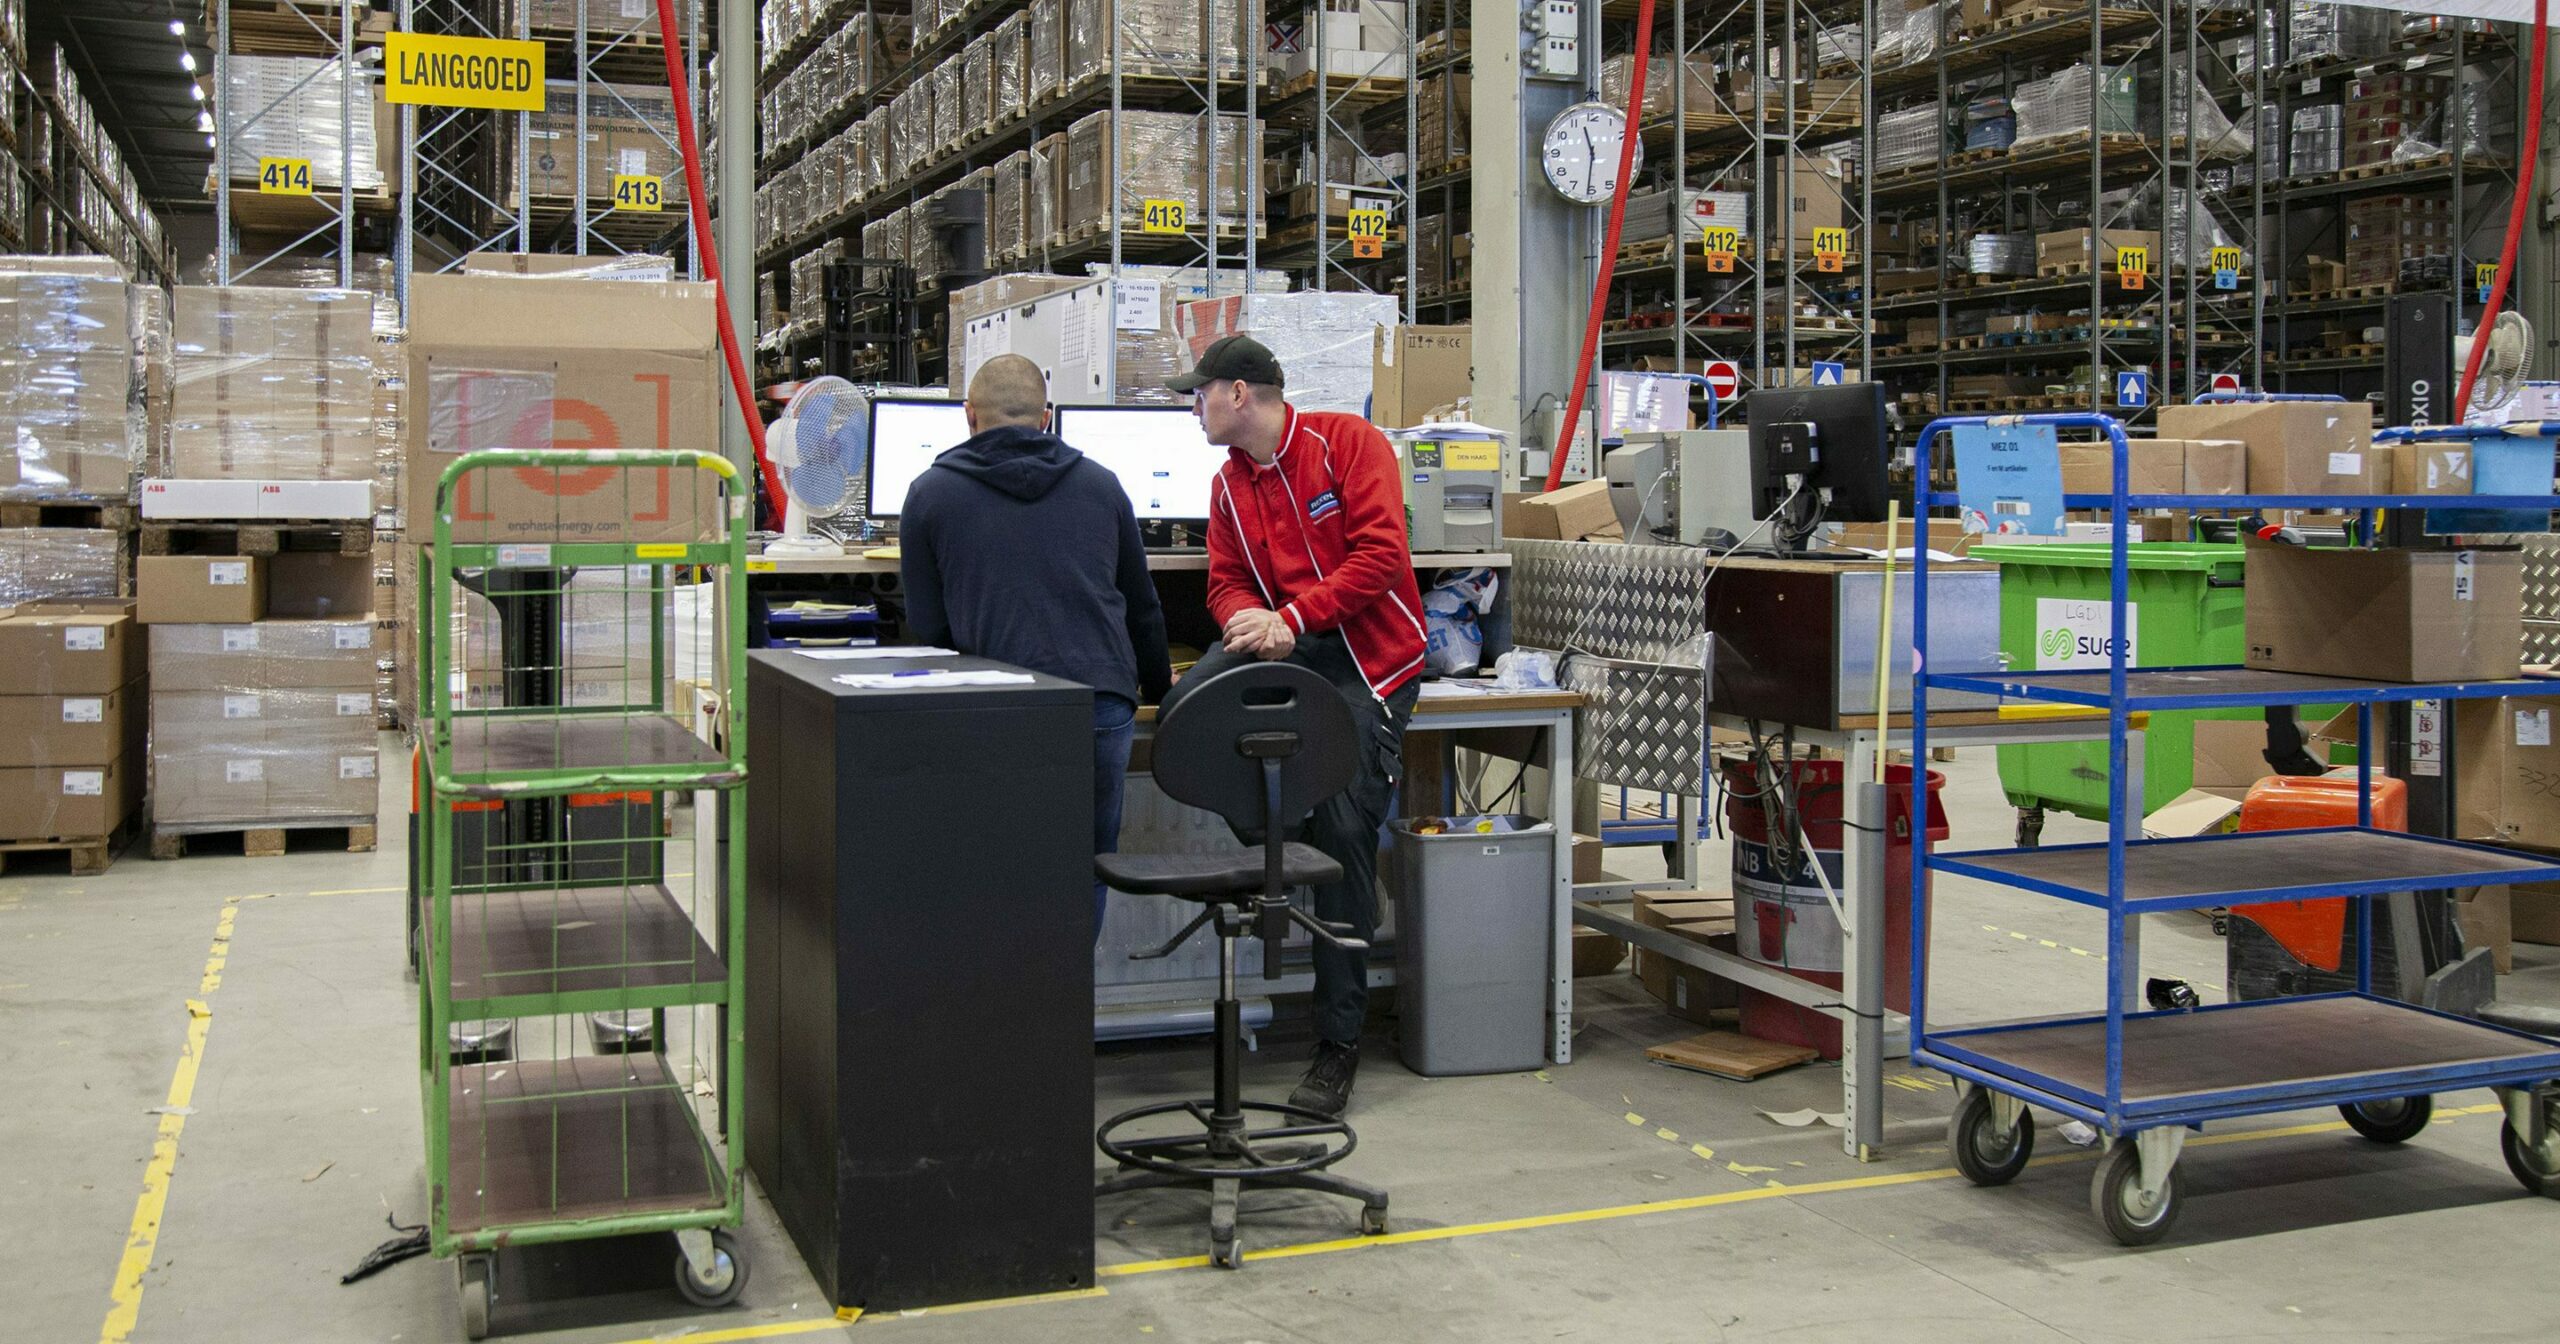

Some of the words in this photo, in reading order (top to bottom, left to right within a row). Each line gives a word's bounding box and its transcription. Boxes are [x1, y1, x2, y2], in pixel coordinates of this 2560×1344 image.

[400, 50, 531, 92] LANGGOED
[1586, 112, 1599, 122] 12
[1608, 118, 1612, 126] 1
[530, 119, 575, 130] RYSTALLINE
[586, 122, 634, 134] OTOVOLTAIC
[1570, 118, 1578, 128] 11
[1557, 131, 1567, 140] 10
[1550, 148, 1560, 158] 9
[263, 163, 309, 189] 414
[1556, 167, 1567, 176] 8
[1569, 181, 1578, 190] 7
[1588, 185, 1597, 195] 6
[1605, 180, 1615, 190] 5
[617, 180, 659, 206] 413
[1146, 205, 1182, 228] 413
[1351, 214, 1384, 236] 412
[1705, 231, 1735, 252] 412
[1816, 232, 1842, 252] 411
[2120, 251, 2143, 271] 411
[2214, 252, 2238, 271] 410
[1449, 338, 1460, 348] CE
[147, 485, 166, 493] ABB
[262, 485, 281, 493] ABB
[508, 520, 621, 535] enphaseenergy.com
